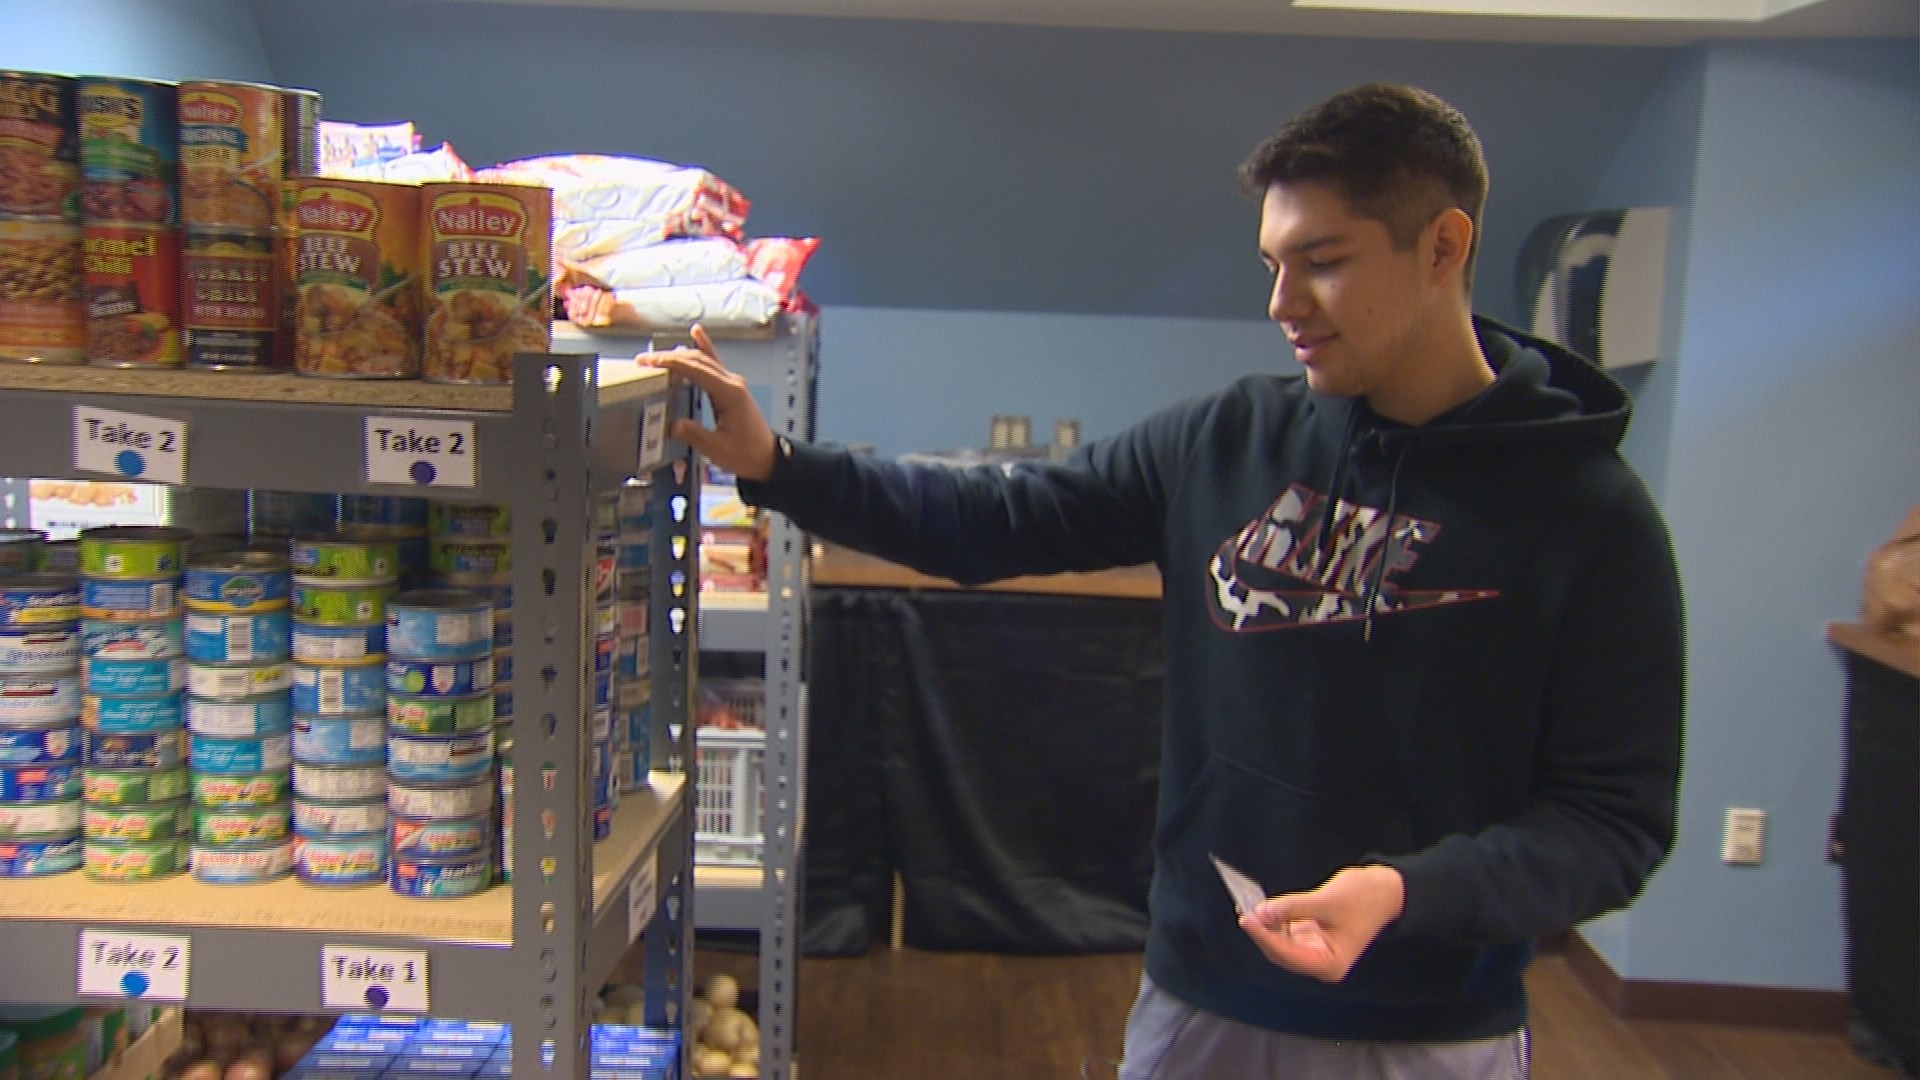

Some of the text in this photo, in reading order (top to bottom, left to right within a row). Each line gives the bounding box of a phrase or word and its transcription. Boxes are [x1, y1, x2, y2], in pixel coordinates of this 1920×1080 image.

[298, 203, 367, 231] Nalley
[437, 207, 515, 235] Nalley
[82, 233, 157, 256] ormel
[303, 236, 351, 254] BEEF
[447, 240, 501, 258] BEEF
[84, 253, 132, 275] Chili
[298, 252, 362, 274] STEW
[438, 257, 511, 279] STEW
[195, 281, 259, 303] CHILI
[83, 417, 176, 452] Take 2
[374, 428, 464, 454] Take 2
[89, 940, 180, 971] Take 2
[330, 955, 418, 983] Take 1
